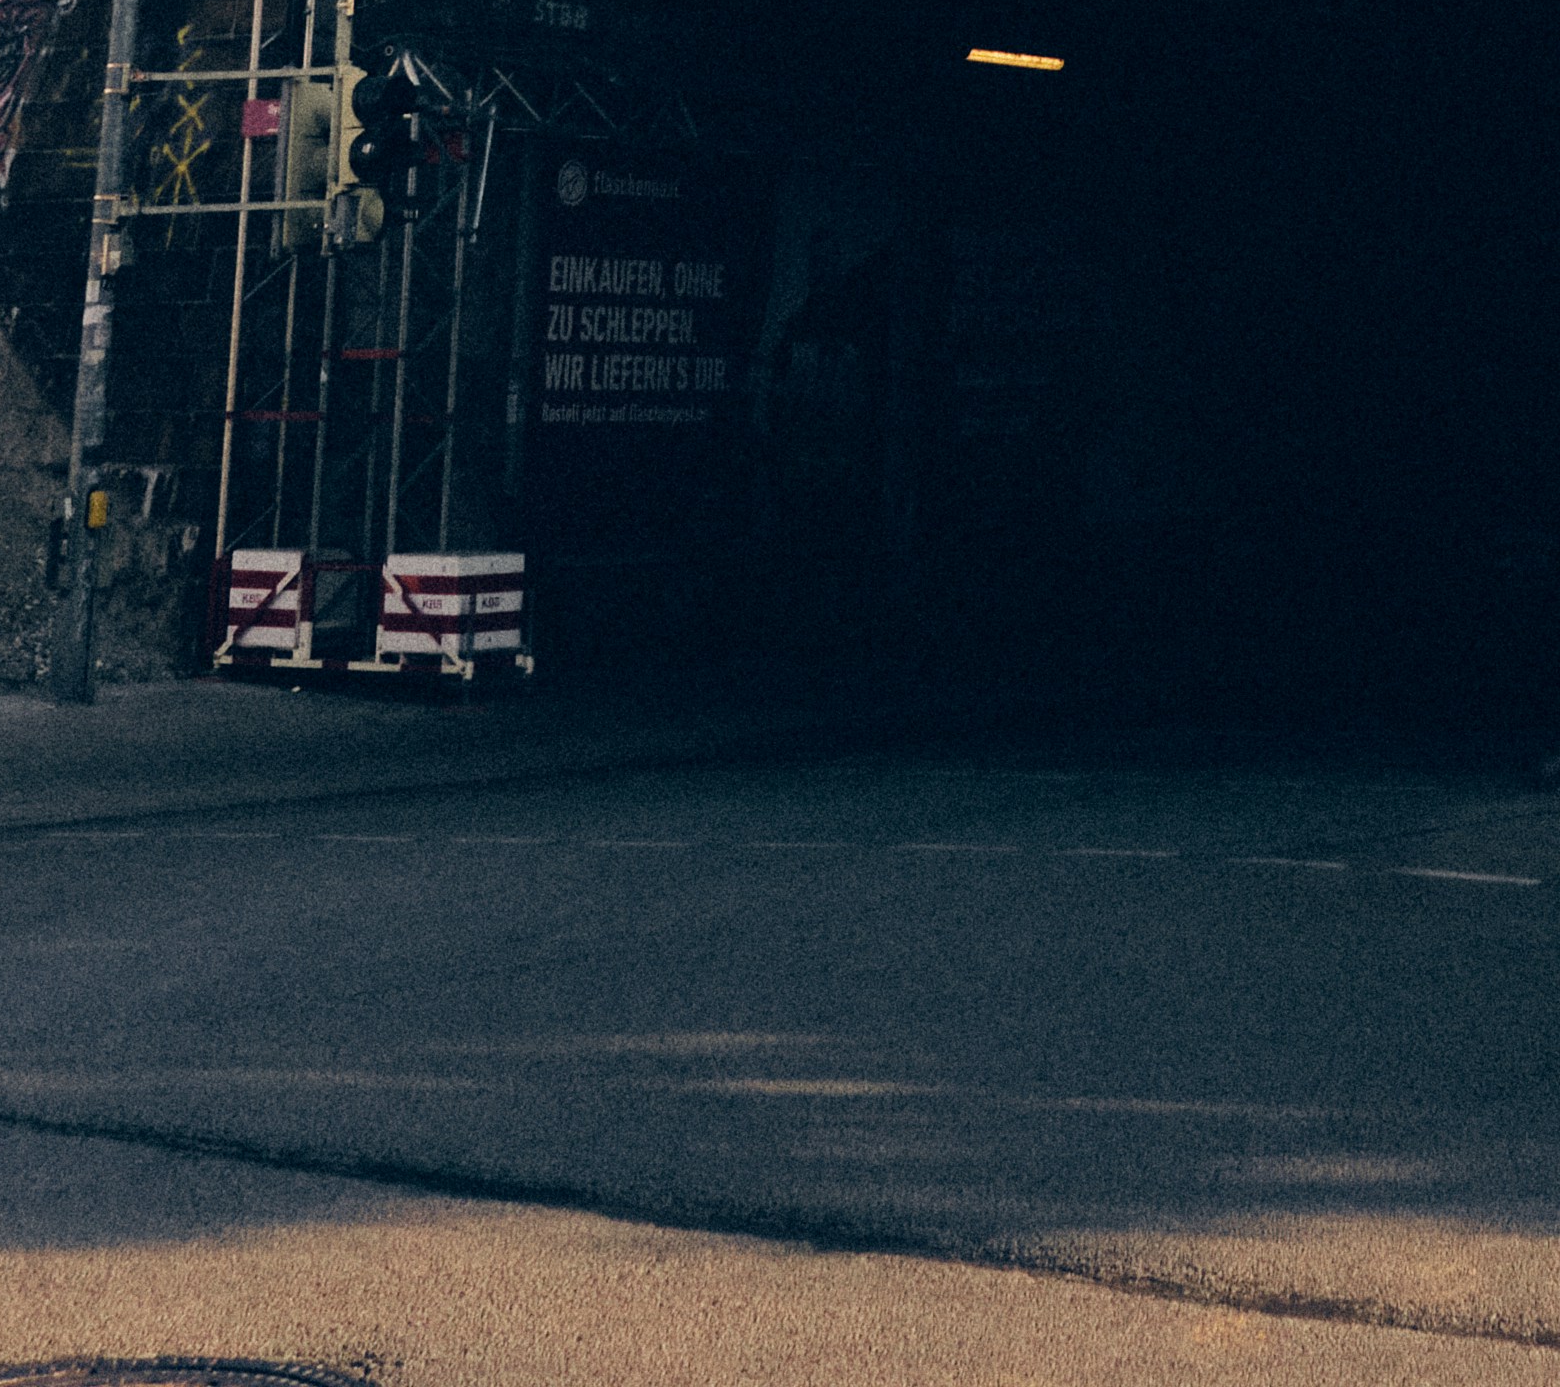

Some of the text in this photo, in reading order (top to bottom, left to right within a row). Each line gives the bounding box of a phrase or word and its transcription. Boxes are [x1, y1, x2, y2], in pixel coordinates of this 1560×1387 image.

[549, 255, 726, 300] EINKAUFEN, OHNE
[547, 304, 698, 344] ZU SCHLEPPEN.
[544, 351, 584, 391] WIR
[590, 355, 688, 391] LIEFERN'S
